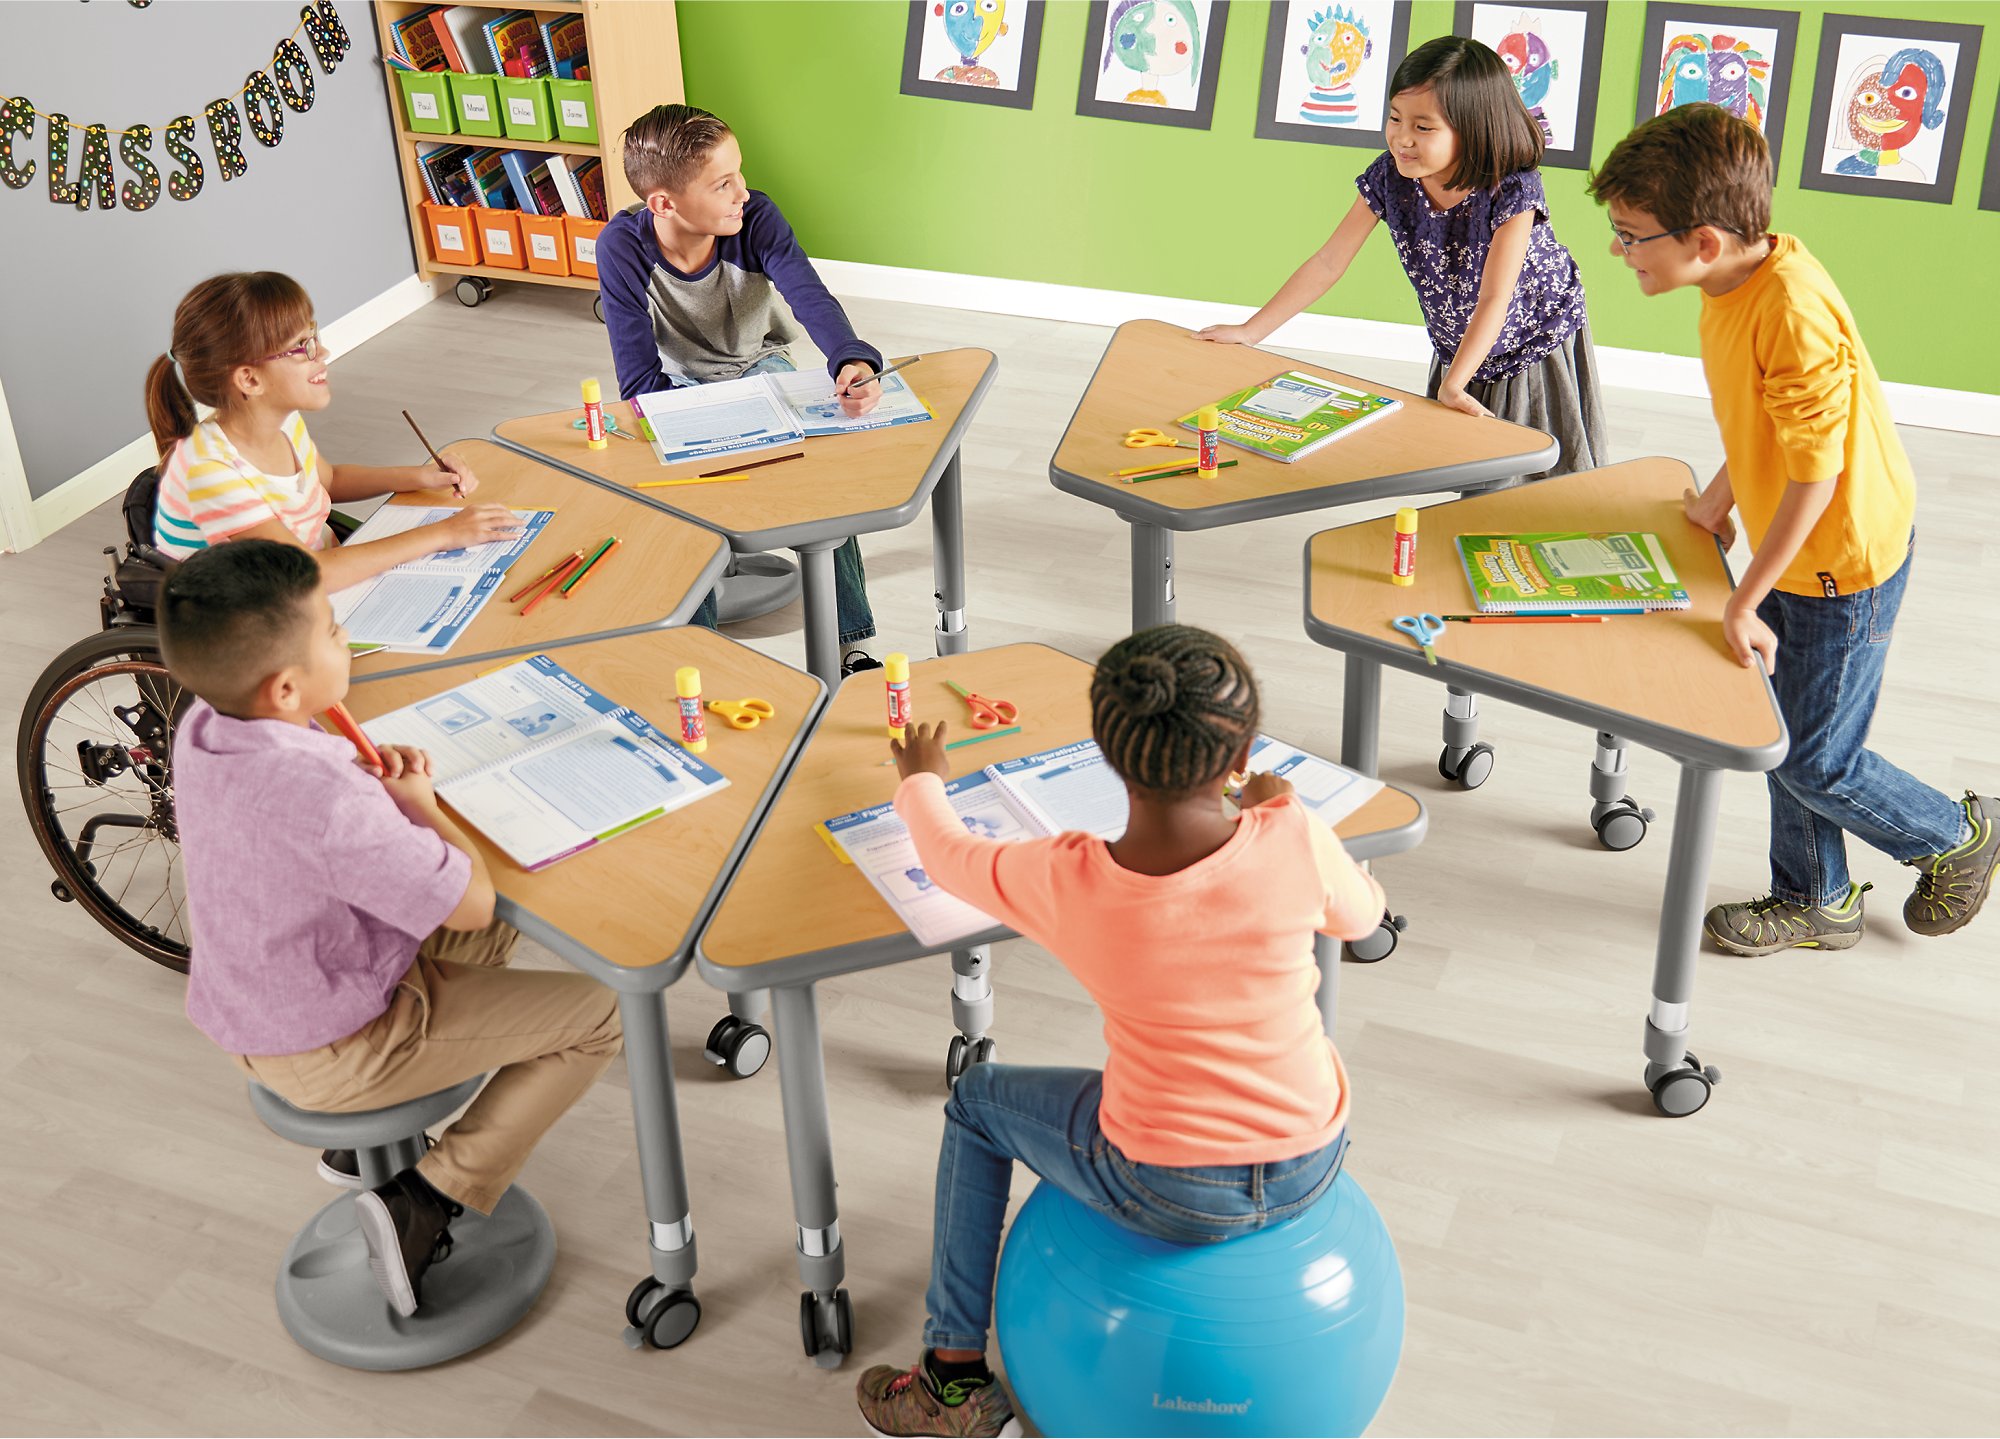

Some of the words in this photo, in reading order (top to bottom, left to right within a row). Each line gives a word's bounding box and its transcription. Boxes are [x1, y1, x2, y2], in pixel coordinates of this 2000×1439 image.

[0, 0, 352, 212] CLASSROOM
[417, 101, 432, 111] Paul
[512, 106, 532, 117] Chloe
[871, 421, 893, 429] Mood
[1223, 422, 1274, 442] Reading
[688, 445, 727, 457] Language
[727, 438, 768, 450] Figurative
[1483, 554, 1510, 584] Reading
[1495, 541, 1538, 594] Comprehension
[1555, 584, 1580, 597] 40
[643, 727, 678, 753] Figurative
[1029, 746, 1078, 764] Figurative
[1152, 1392, 1249, 1415] Lakeshore
